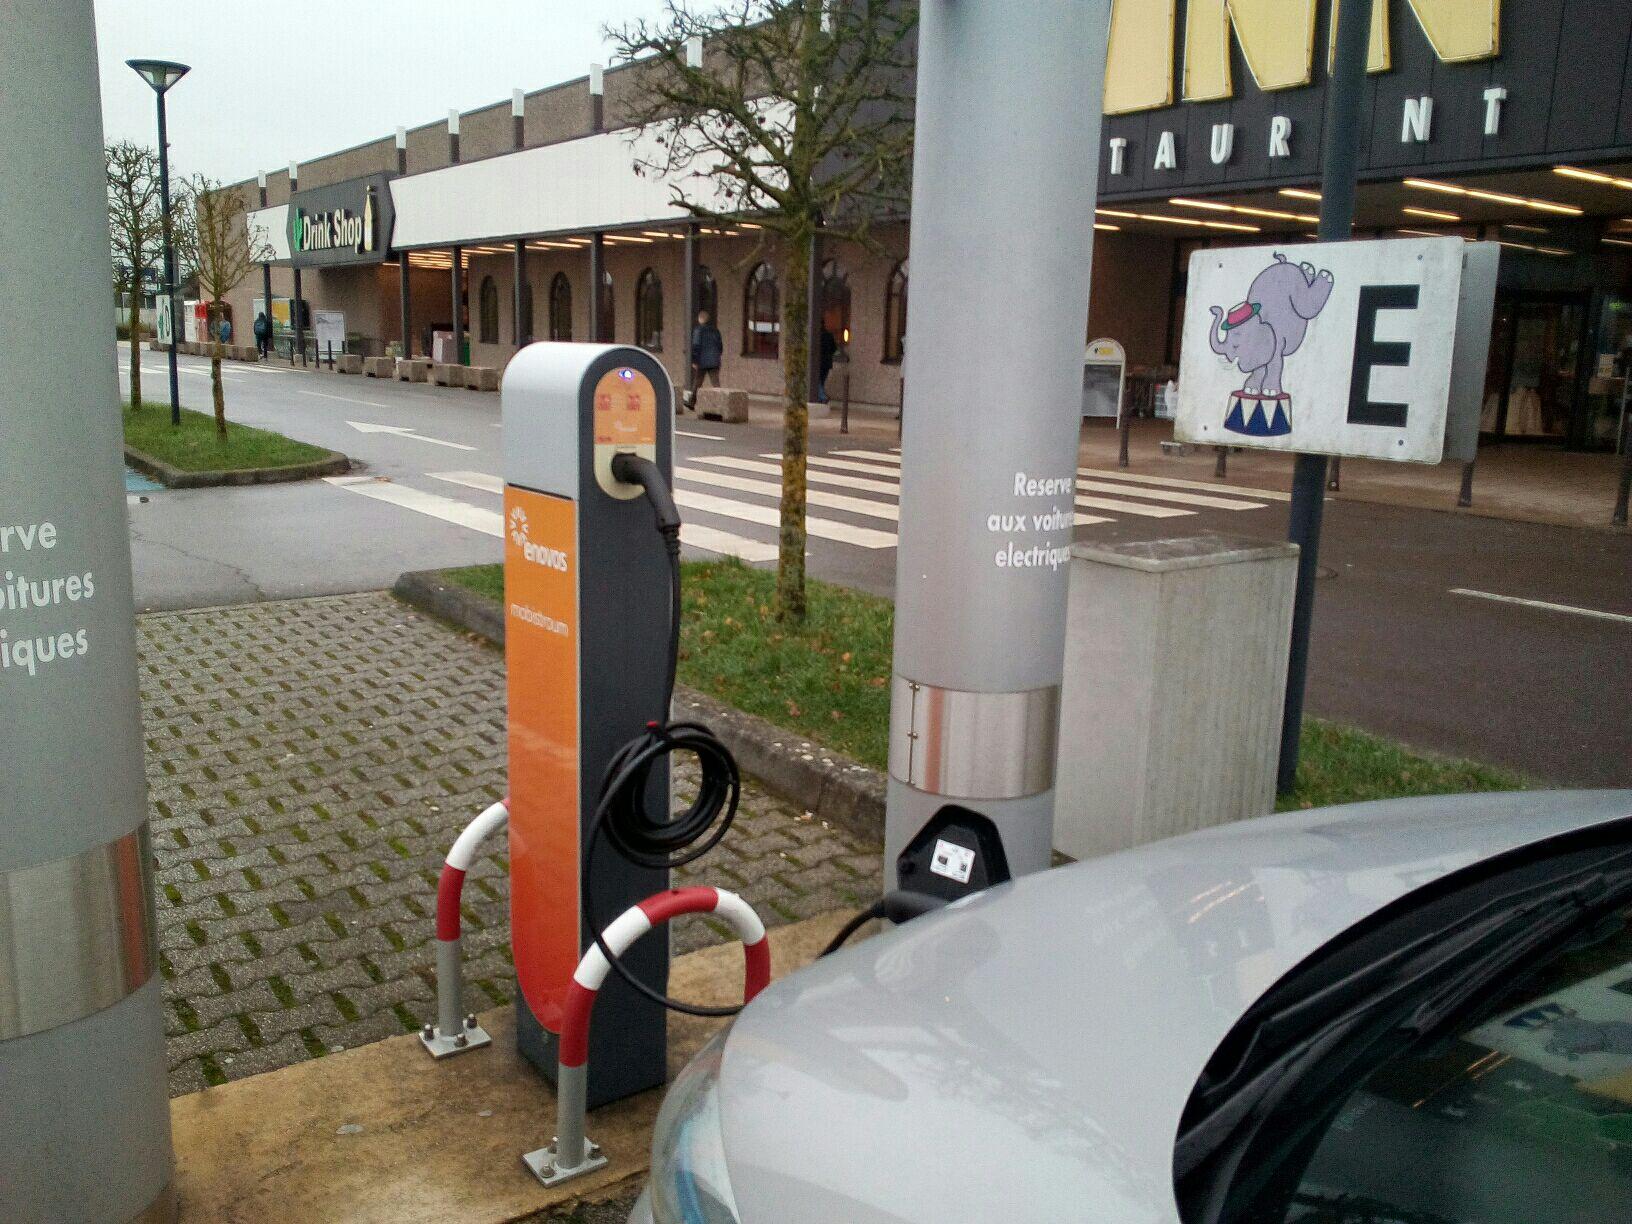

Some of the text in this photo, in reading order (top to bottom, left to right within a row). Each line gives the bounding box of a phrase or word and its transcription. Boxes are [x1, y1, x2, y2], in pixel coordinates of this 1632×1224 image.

[1109, 88, 1507, 175] TAURNT
[303, 208, 362, 254] Drink Shop
[1346, 284, 1421, 428] E
[987, 512, 1027, 532] aux
